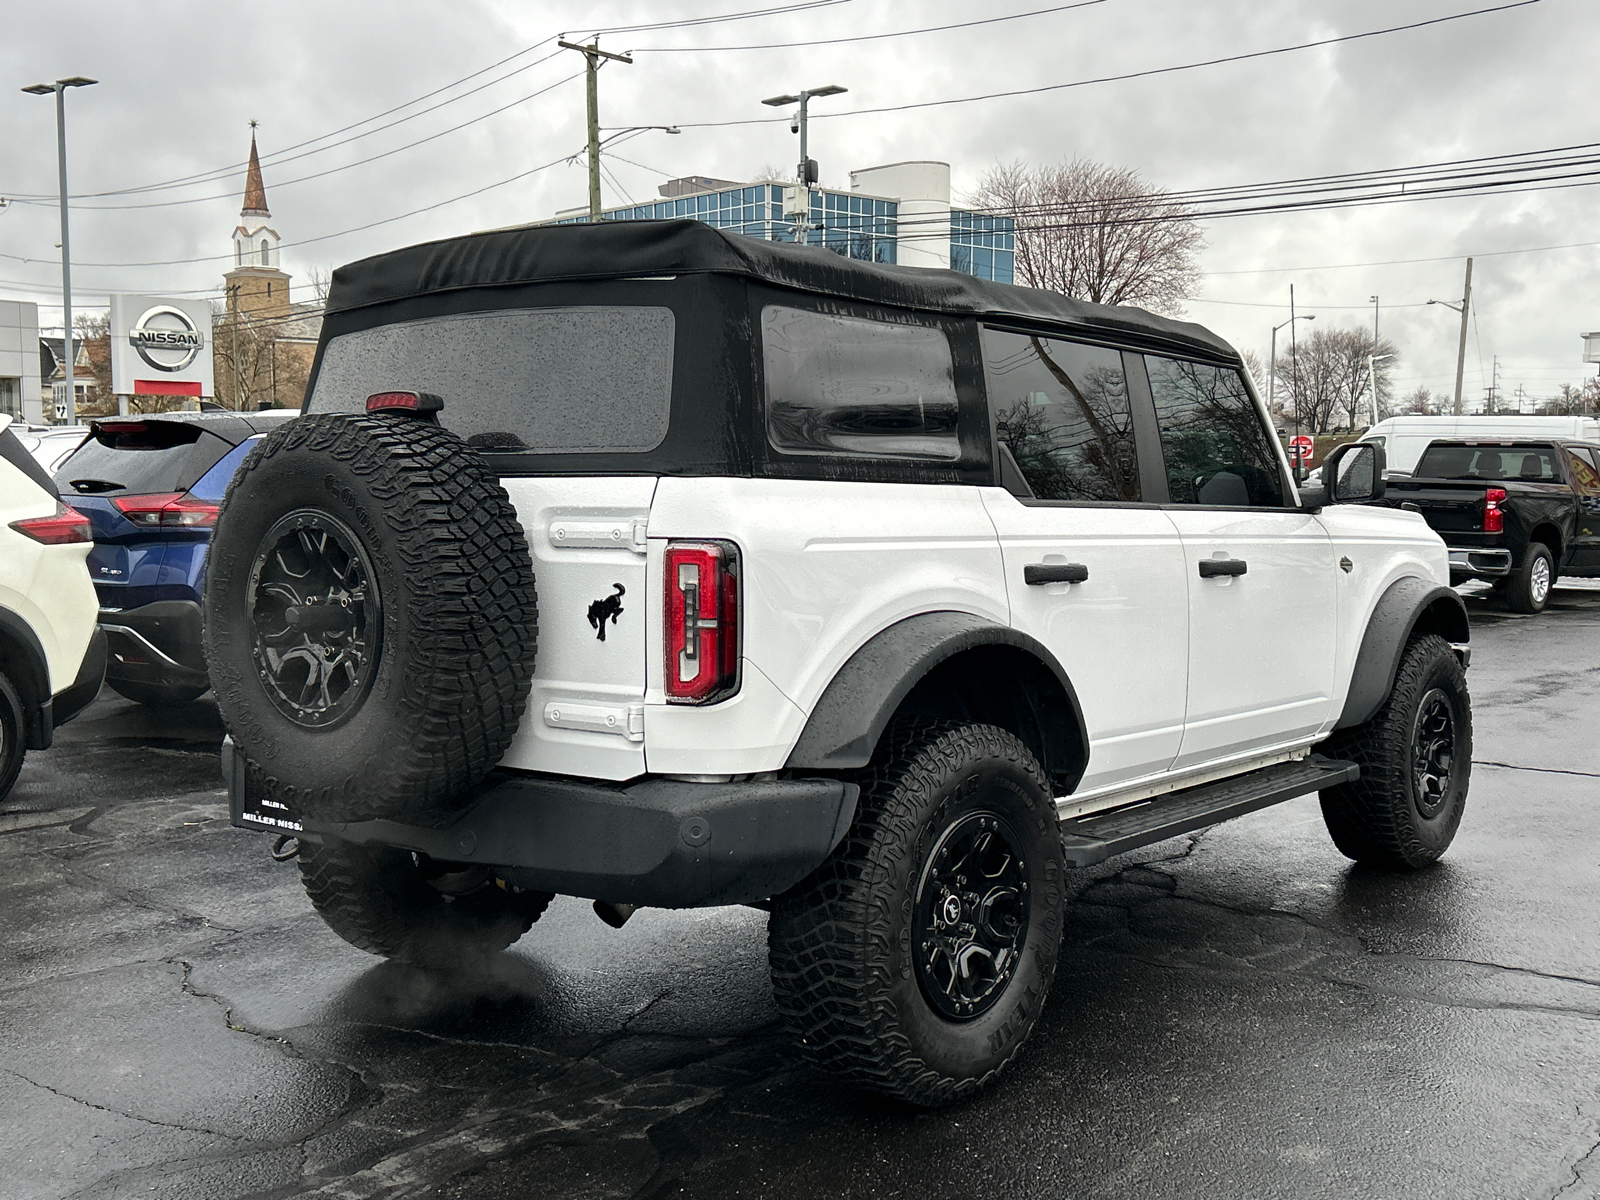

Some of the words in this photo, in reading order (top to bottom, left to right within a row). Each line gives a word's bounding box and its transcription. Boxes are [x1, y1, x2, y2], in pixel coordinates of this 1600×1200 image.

[138, 332, 198, 345] NISSAN
[262, 799, 279, 808] MILLER
[242, 812, 276, 826] MILLER
